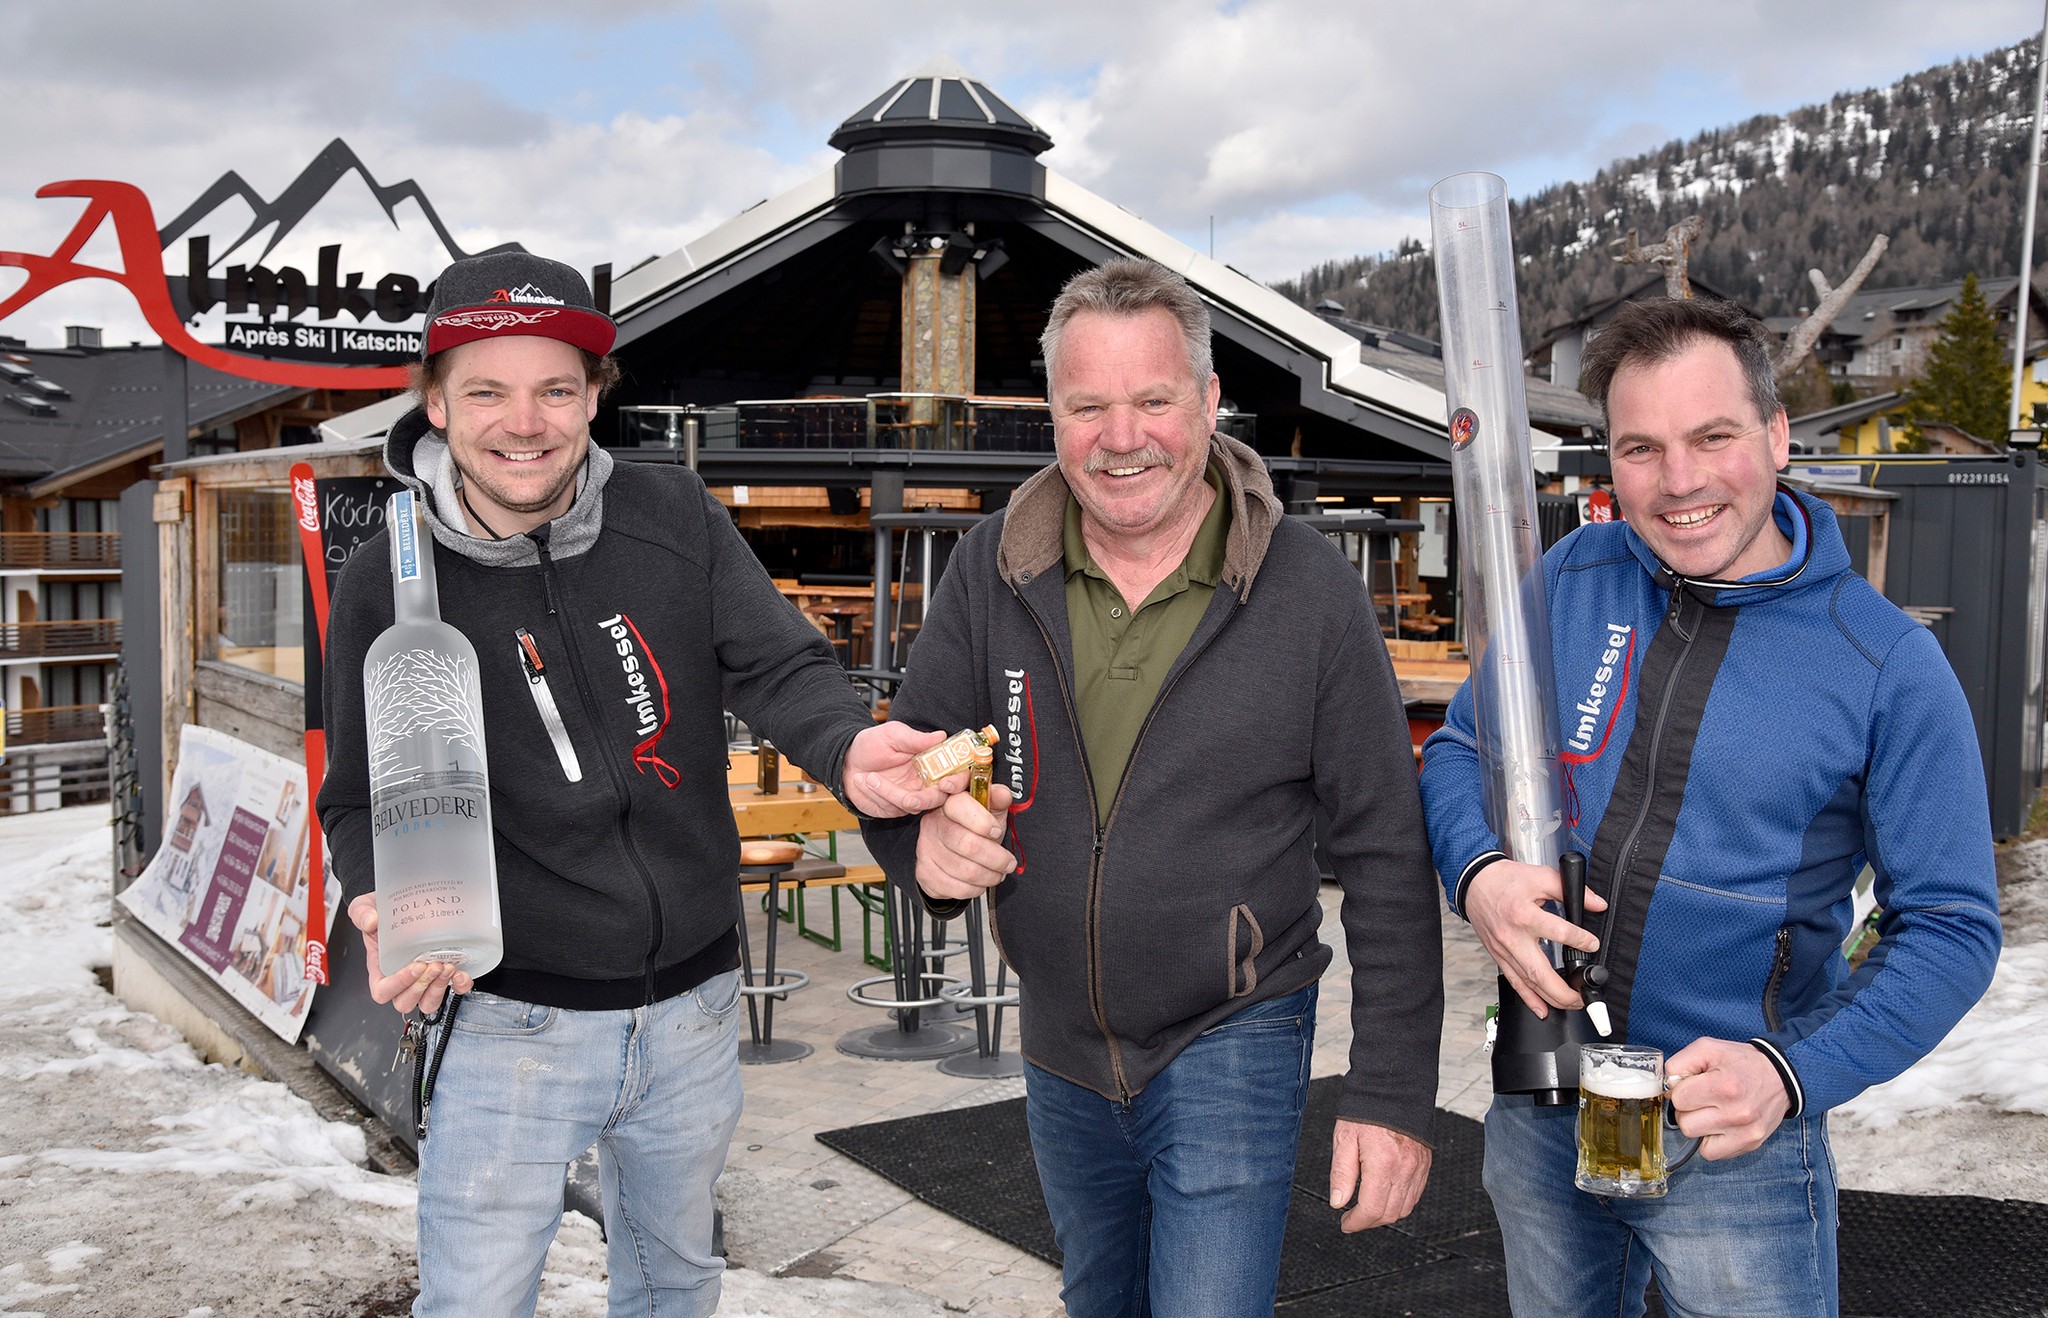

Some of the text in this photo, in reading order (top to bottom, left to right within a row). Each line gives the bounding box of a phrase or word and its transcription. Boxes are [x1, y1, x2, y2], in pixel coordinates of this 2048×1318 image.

[229, 324, 290, 349] Après
[294, 327, 326, 348] Ski
[342, 330, 421, 353] Katschb
[294, 476, 320, 532] Coca-Cola
[324, 492, 384, 530] Küch
[400, 508, 412, 551] BELVEDERE
[374, 796, 477, 837] BELVEDERE
[392, 896, 461, 916] POLAND
[430, 910, 435, 918] 3
